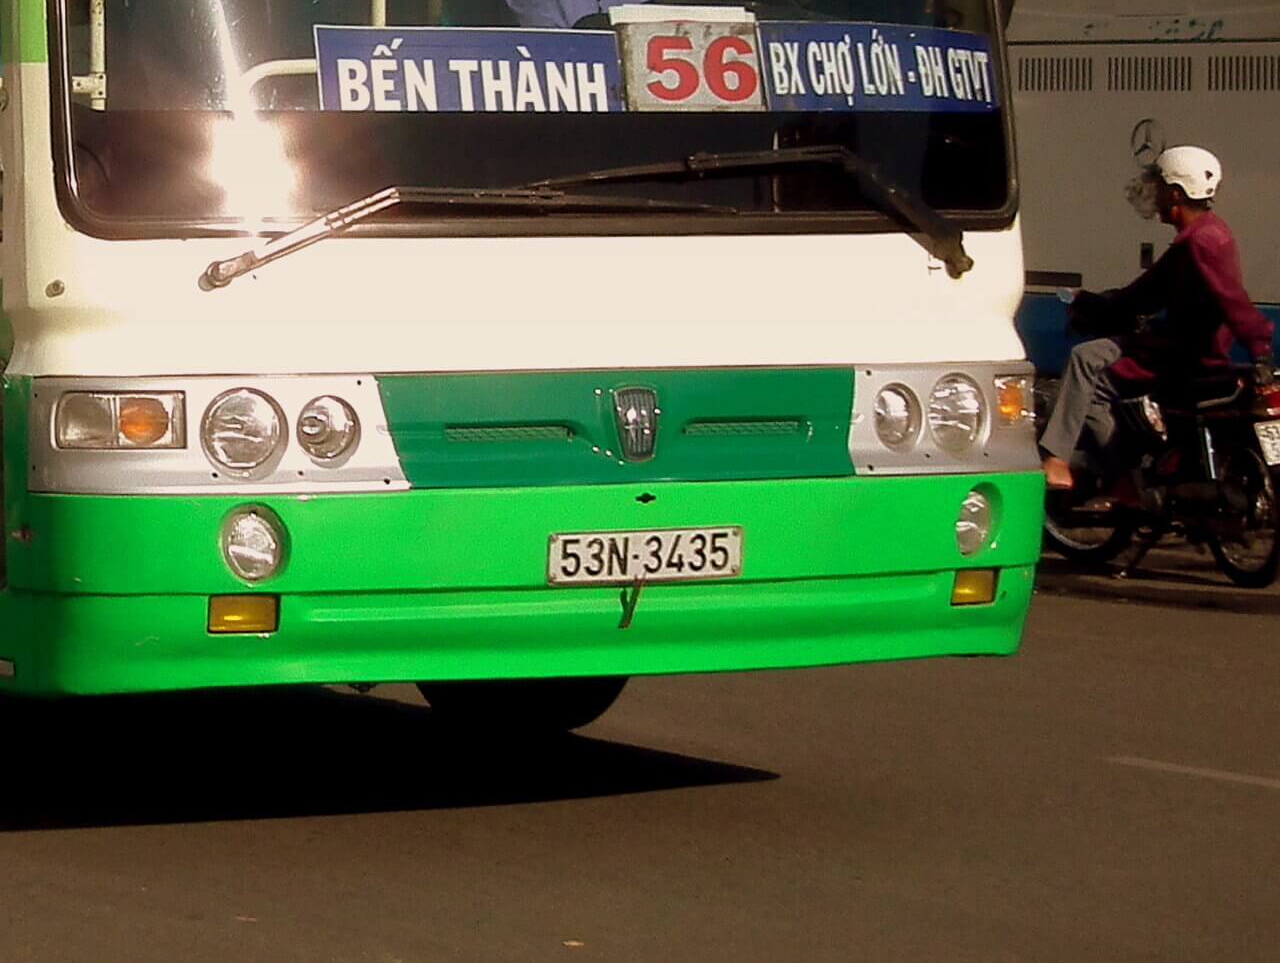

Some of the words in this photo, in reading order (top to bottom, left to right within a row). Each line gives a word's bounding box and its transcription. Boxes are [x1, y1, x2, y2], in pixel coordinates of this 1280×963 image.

[336, 38, 438, 111] BẾN
[448, 46, 609, 112] THÀNH
[646, 35, 758, 102] 56
[768, 41, 806, 95] BX
[806, 34, 855, 106] CHỢ
[857, 29, 905, 95] LỚN
[916, 45, 949, 98] ĐH
[947, 47, 993, 103] GTVT
[560, 532, 729, 578] 53N-3435
